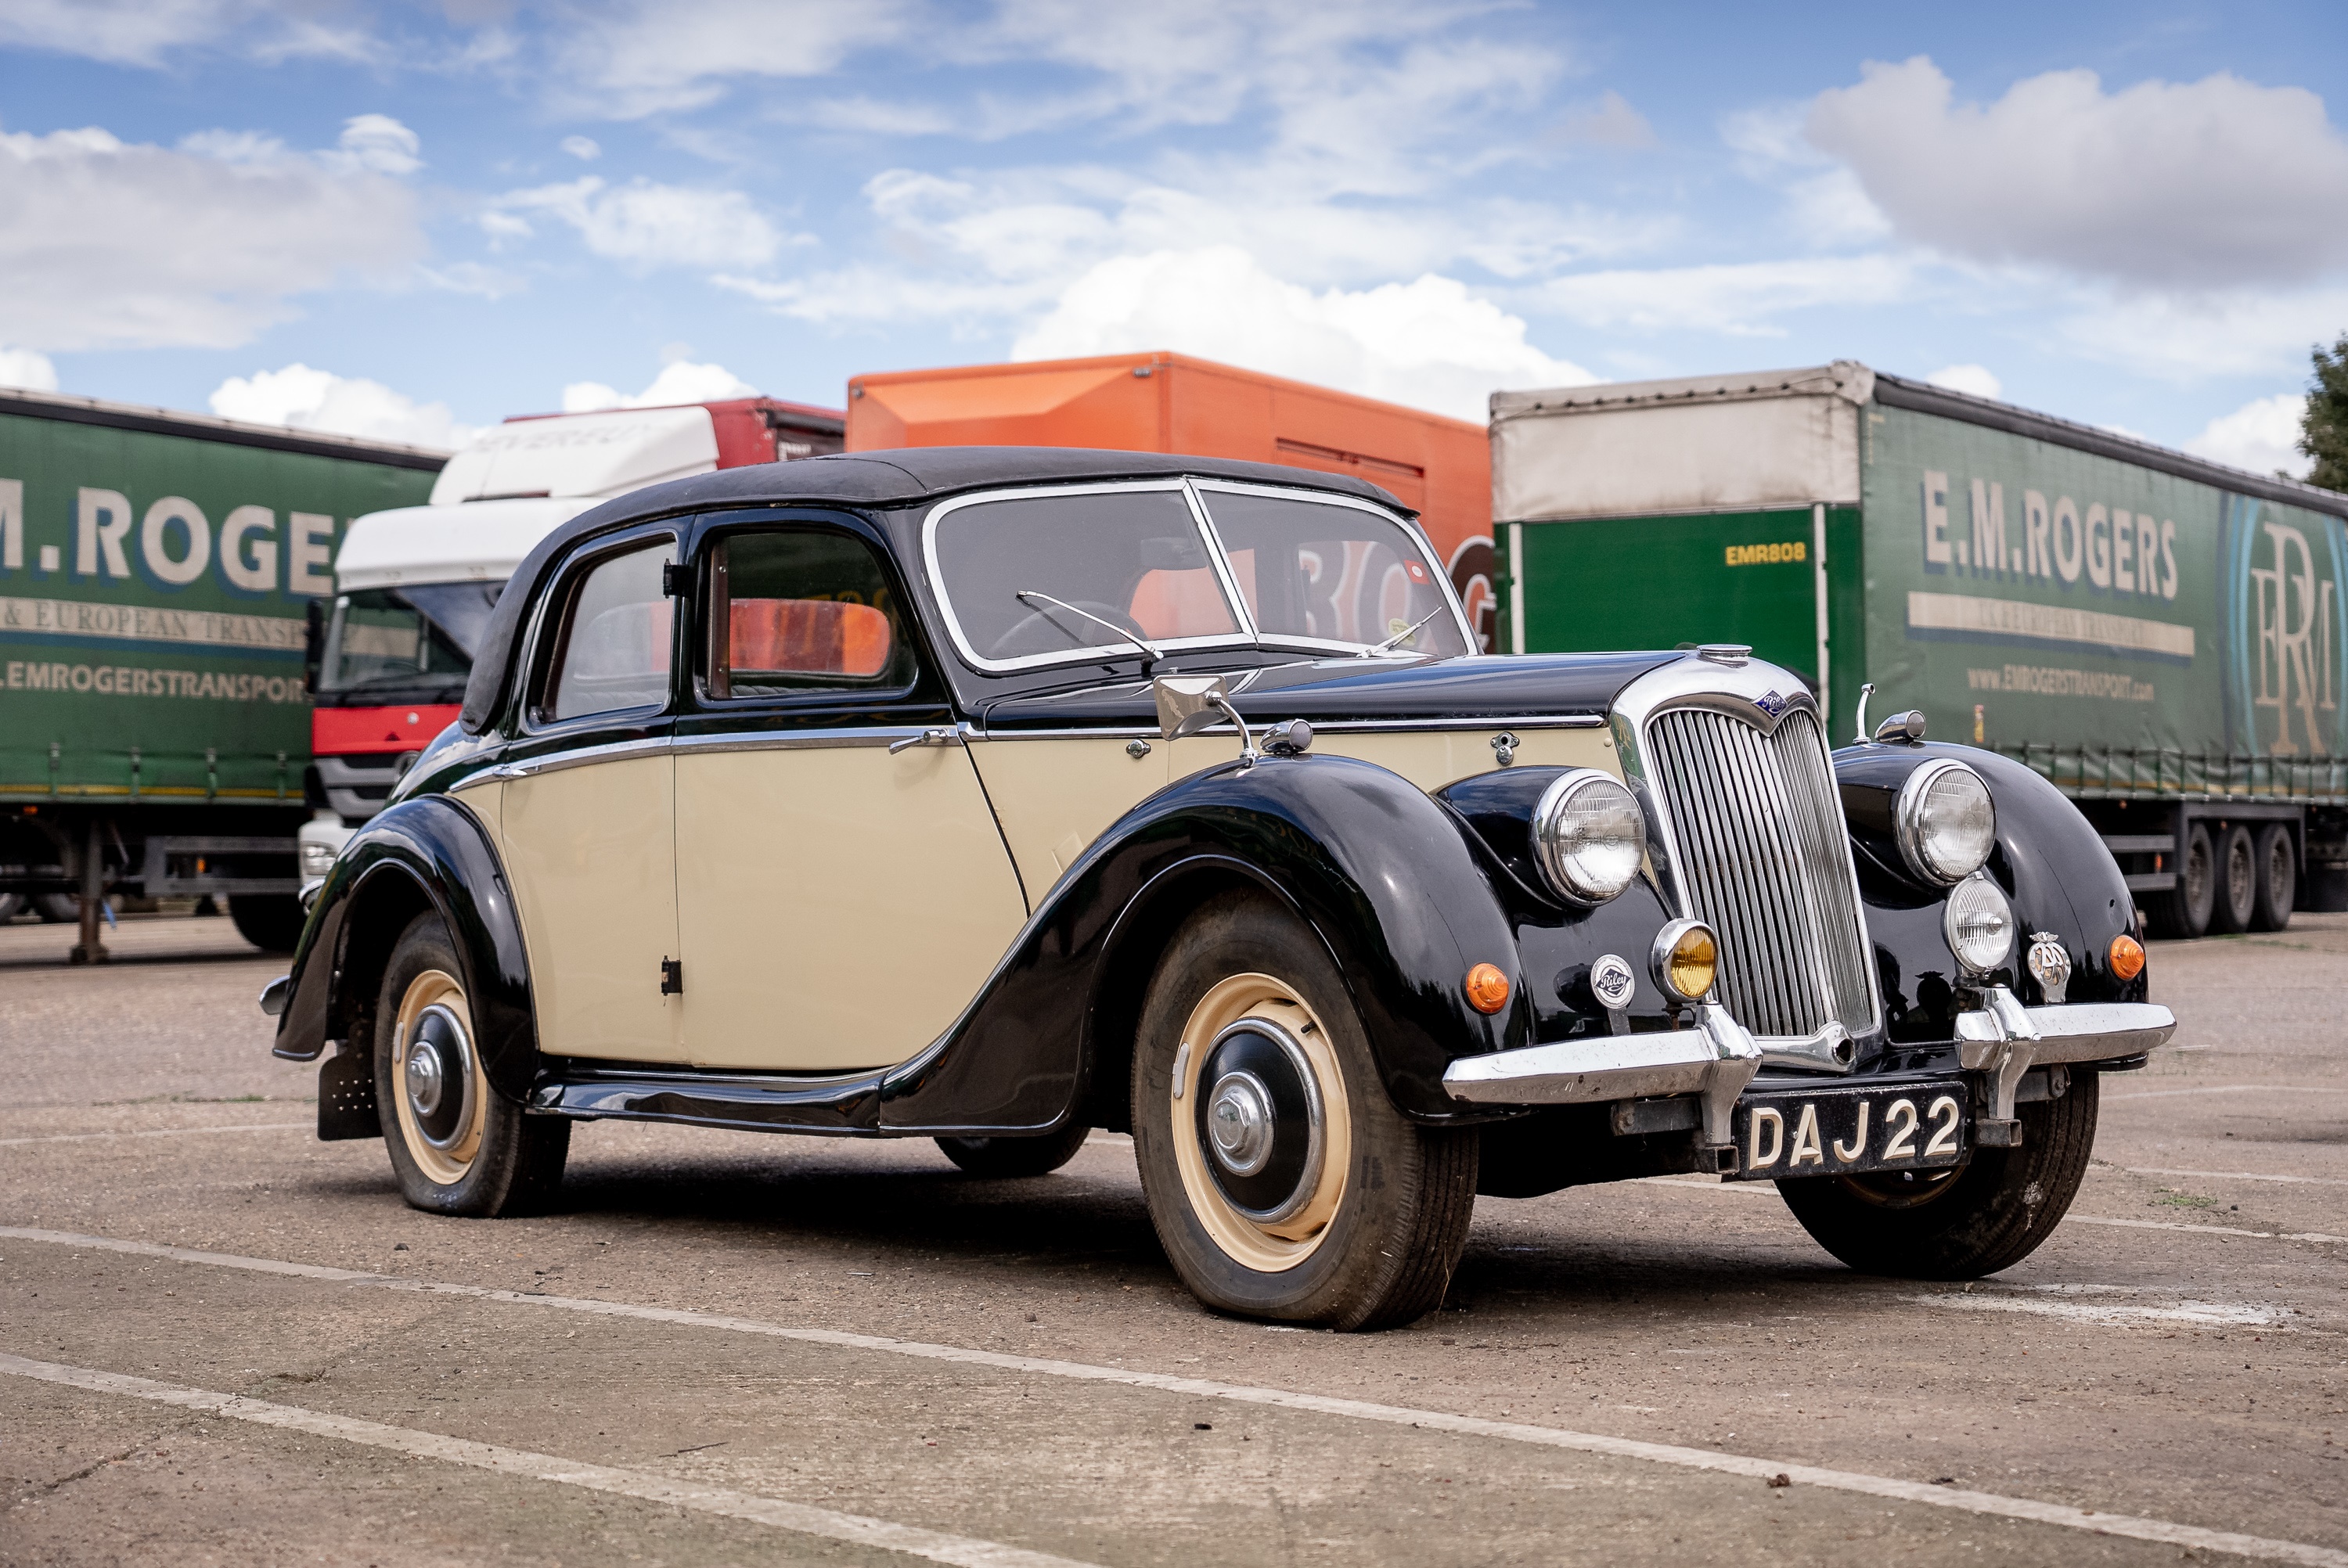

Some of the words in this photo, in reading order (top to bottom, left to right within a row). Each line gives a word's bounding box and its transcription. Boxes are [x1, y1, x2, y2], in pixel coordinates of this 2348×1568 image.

[0, 477, 355, 597] .ROGE
[1725, 541, 1806, 566] EMR808
[1923, 469, 2179, 600] E.M.ROGERS
[5, 600, 21, 626] &
[35, 601, 189, 638] EUROPEAN
[199, 618, 307, 646] TRANSP
[0, 660, 315, 703] .EMROGERSTRANSPOR
[1600, 973, 1626, 992] Riley
[1749, 1102, 1870, 1171] DAJ
[1883, 1095, 1960, 1160] 22
